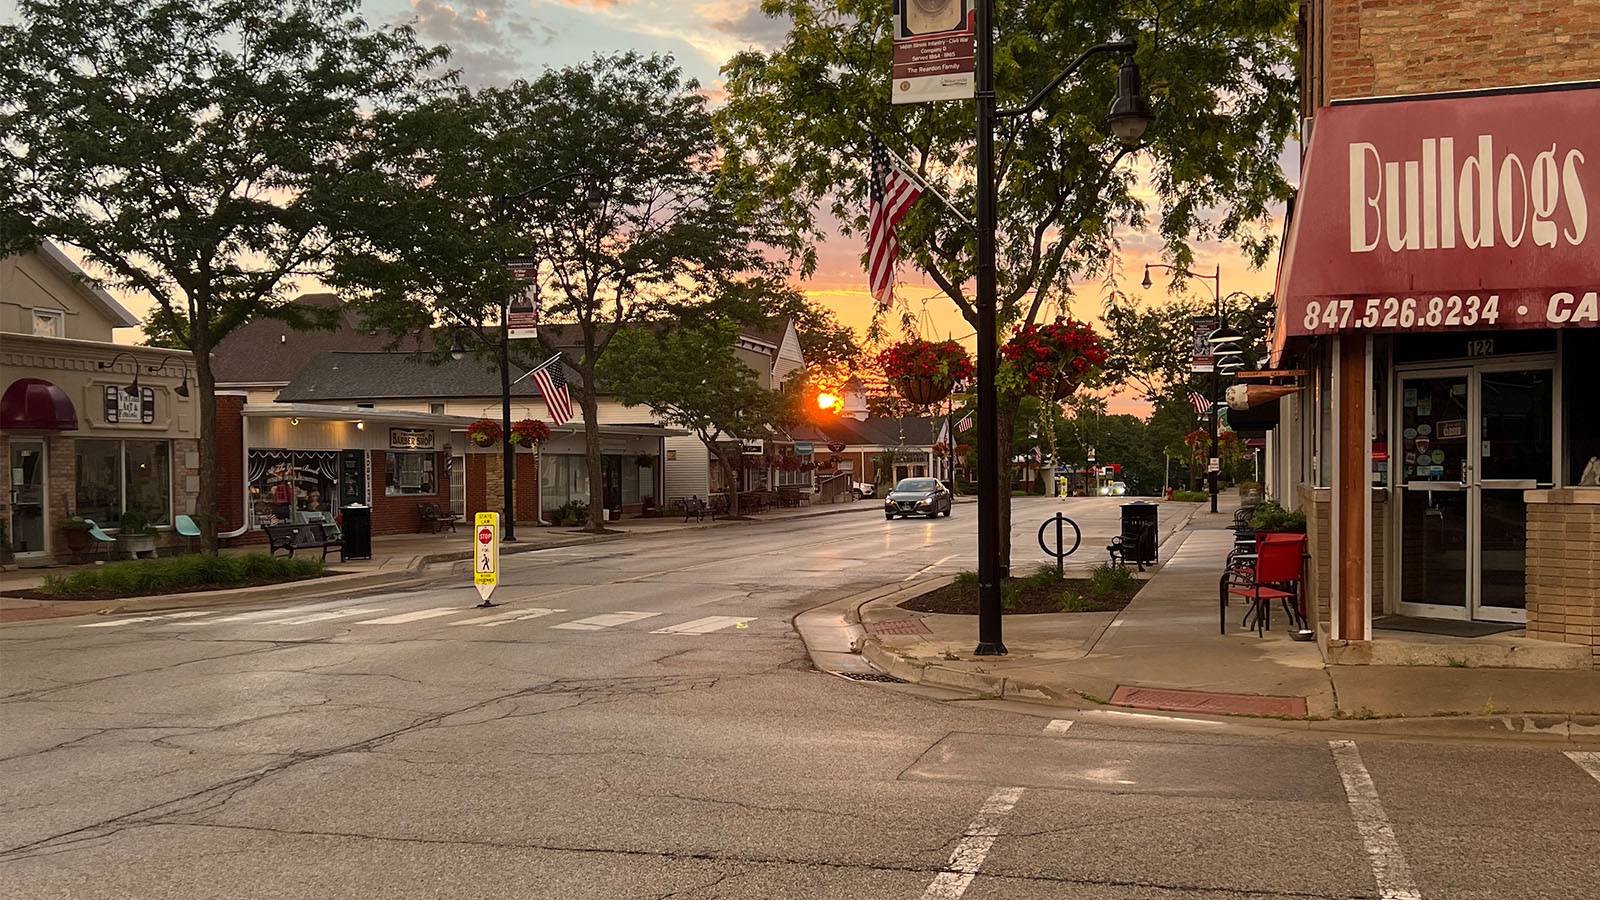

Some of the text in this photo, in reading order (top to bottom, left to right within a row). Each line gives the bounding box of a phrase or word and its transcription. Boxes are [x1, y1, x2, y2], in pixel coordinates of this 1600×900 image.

[919, 65, 941, 73] Reardon
[942, 63, 960, 71] Family
[1349, 134, 1588, 252] Bulldogs
[1303, 292, 1599, 330] 847.526.8234 CA
[1467, 339, 1494, 355] 122
[392, 432, 433, 446] BARBER SHOP
